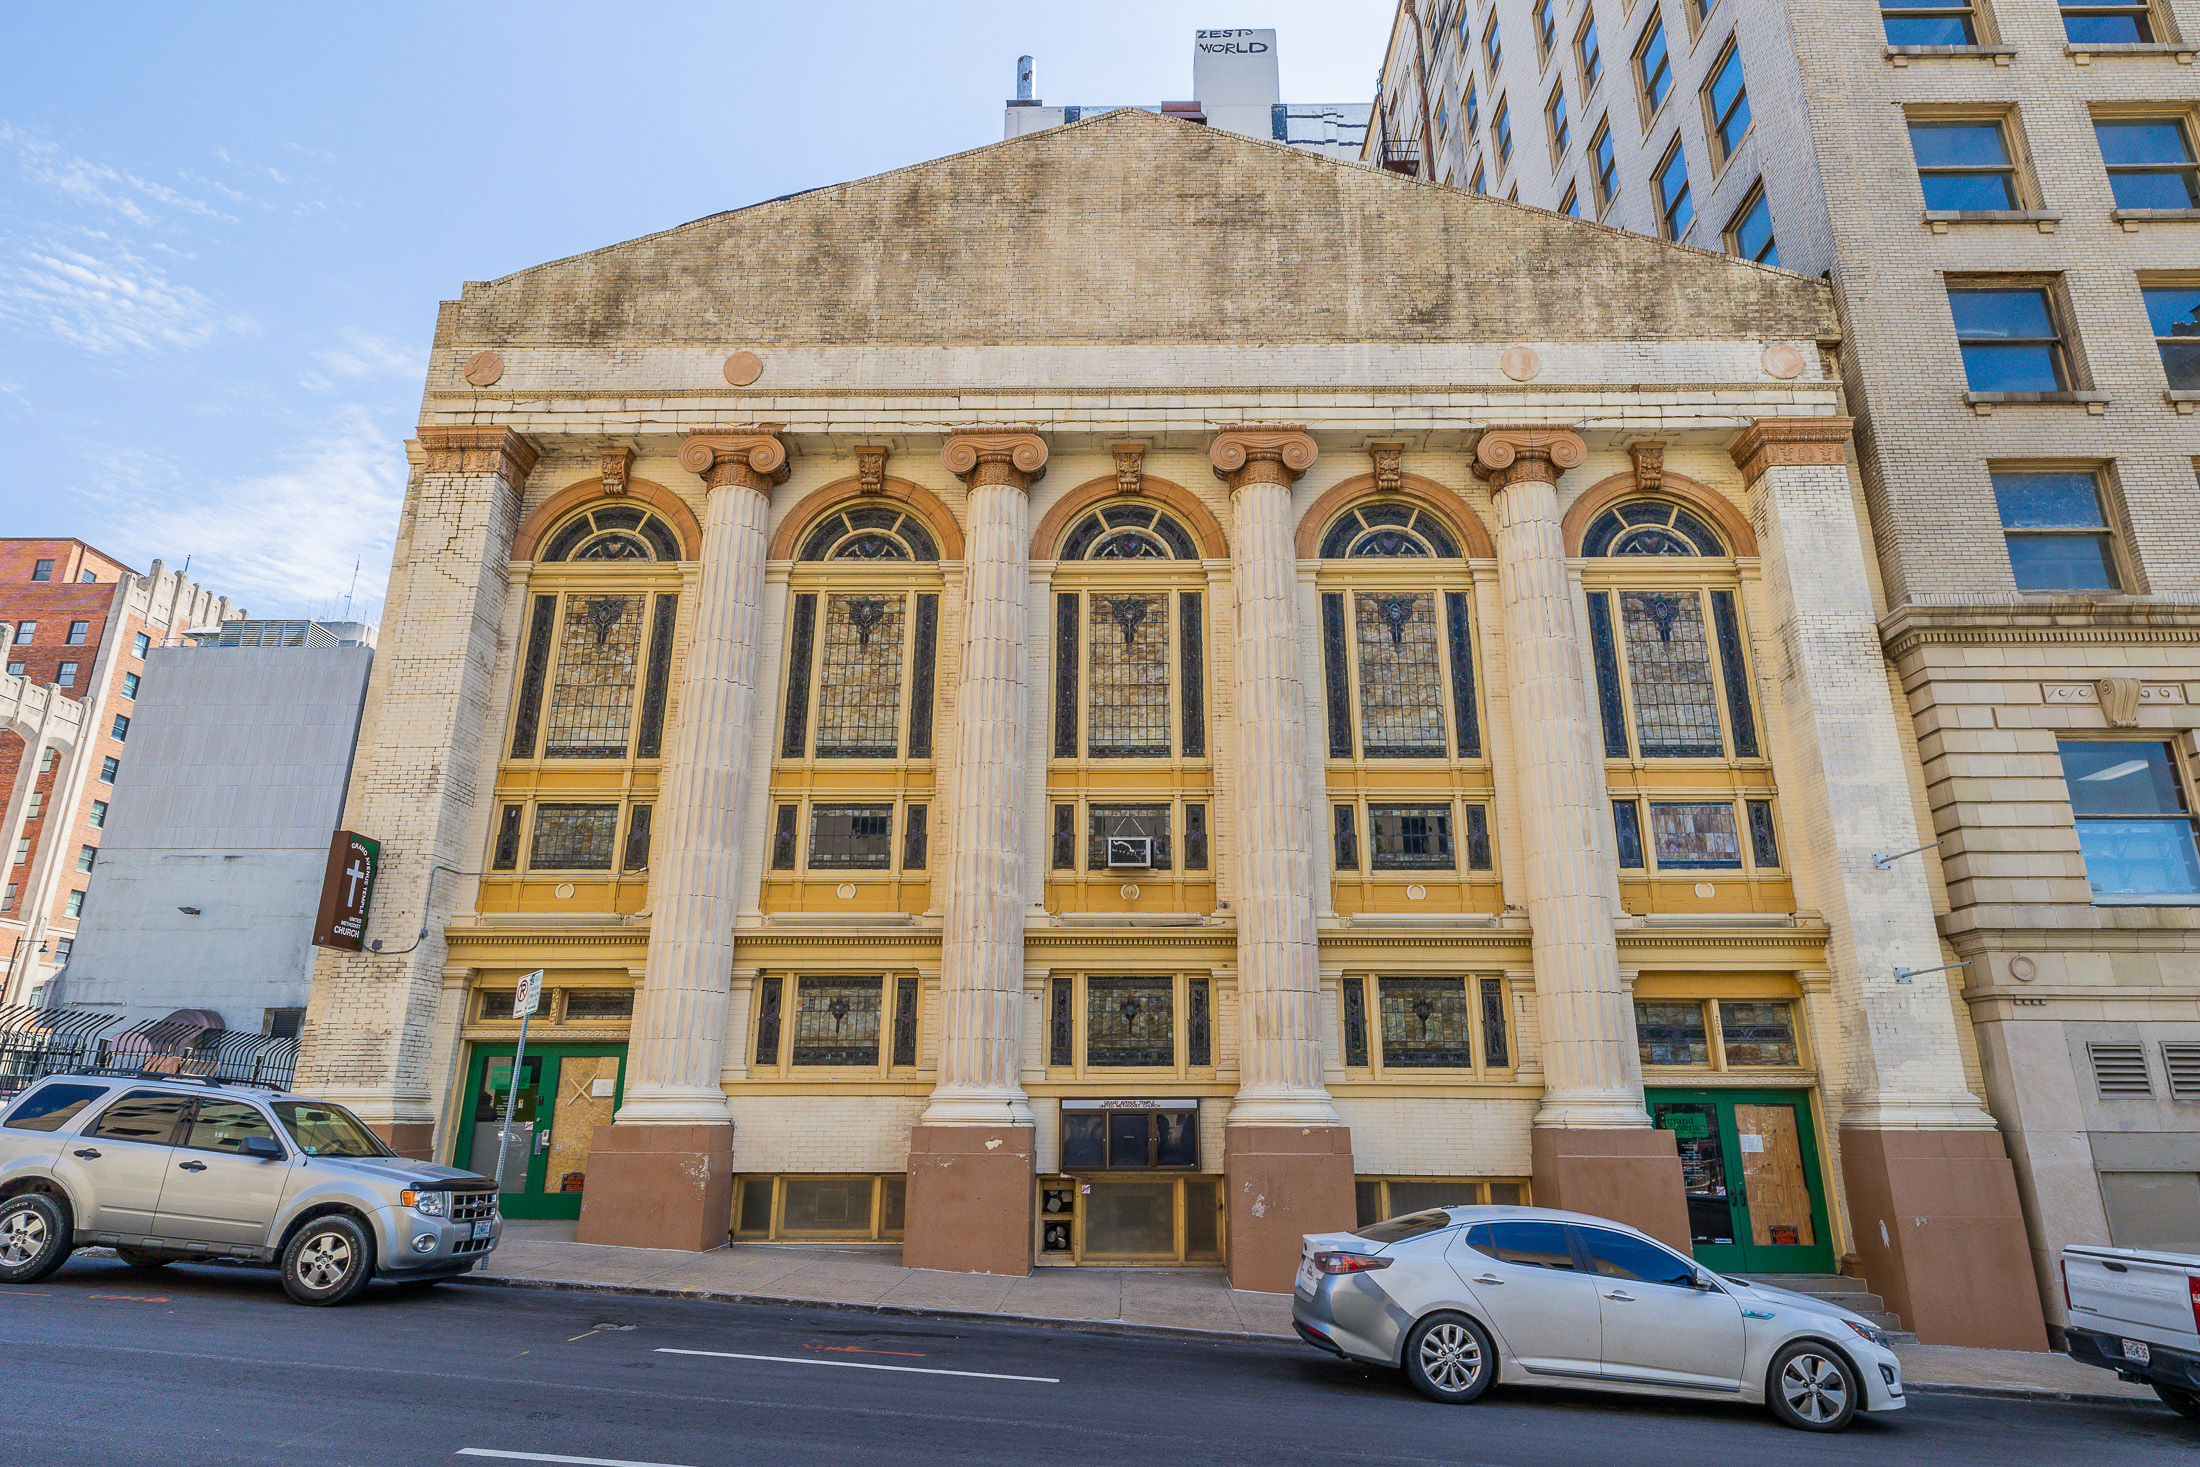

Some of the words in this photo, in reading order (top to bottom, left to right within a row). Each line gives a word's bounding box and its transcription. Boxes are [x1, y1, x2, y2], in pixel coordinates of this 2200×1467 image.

[1199, 42, 1269, 54] WORLD
[351, 842, 368, 857] GRAND
[359, 887, 367, 915] TEMPLE
[341, 921, 361, 929] METHODIST
[349, 916, 362, 924] UNITED
[334, 926, 360, 938] CHURCH
[1667, 1116, 1694, 1126] grand
